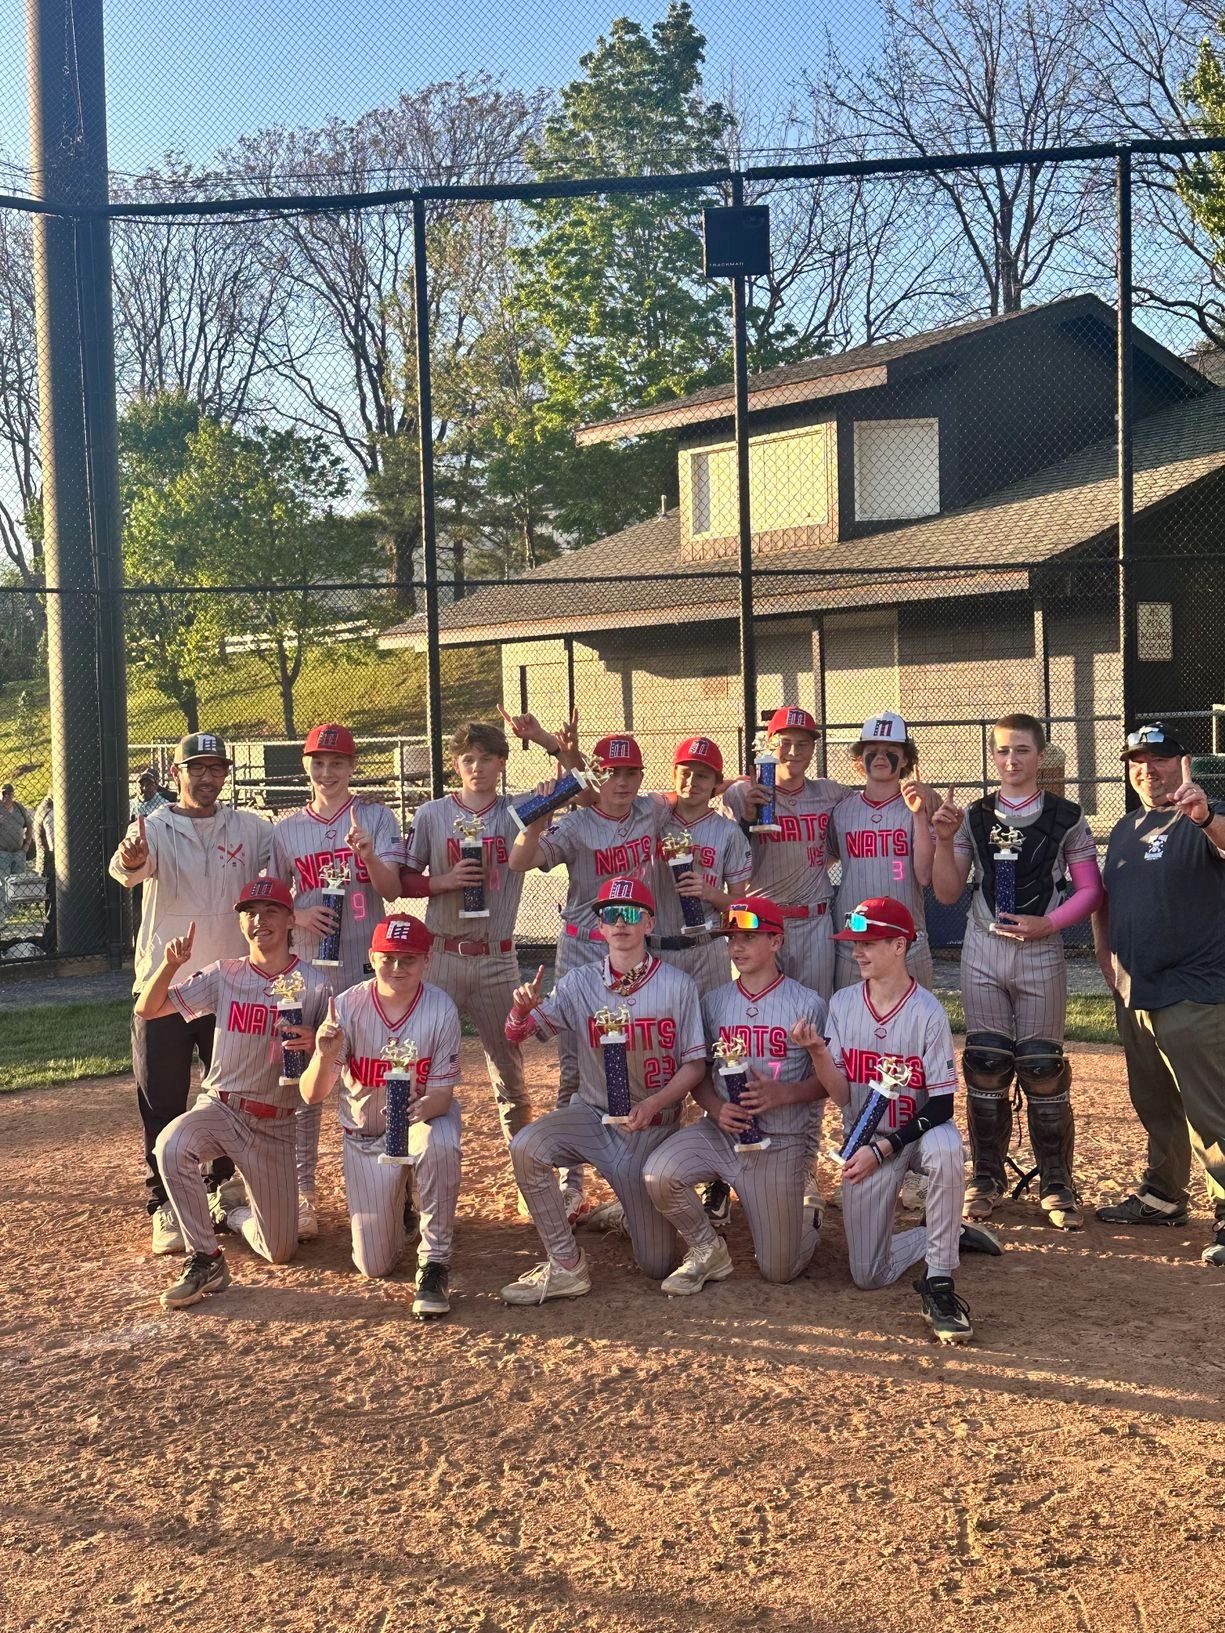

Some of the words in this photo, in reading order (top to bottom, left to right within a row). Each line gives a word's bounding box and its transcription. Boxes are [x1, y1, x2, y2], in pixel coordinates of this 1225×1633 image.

[447, 835, 509, 865] NTS
[595, 835, 652, 876] NATS
[846, 828, 909, 858] NATS
[891, 860, 905, 881] 3
[352, 891, 368, 922] 9
[228, 1001, 280, 1037] NAT
[350, 1056, 431, 1087] NAS
[644, 1056, 676, 1089] 23
[767, 1060, 783, 1081] 7
